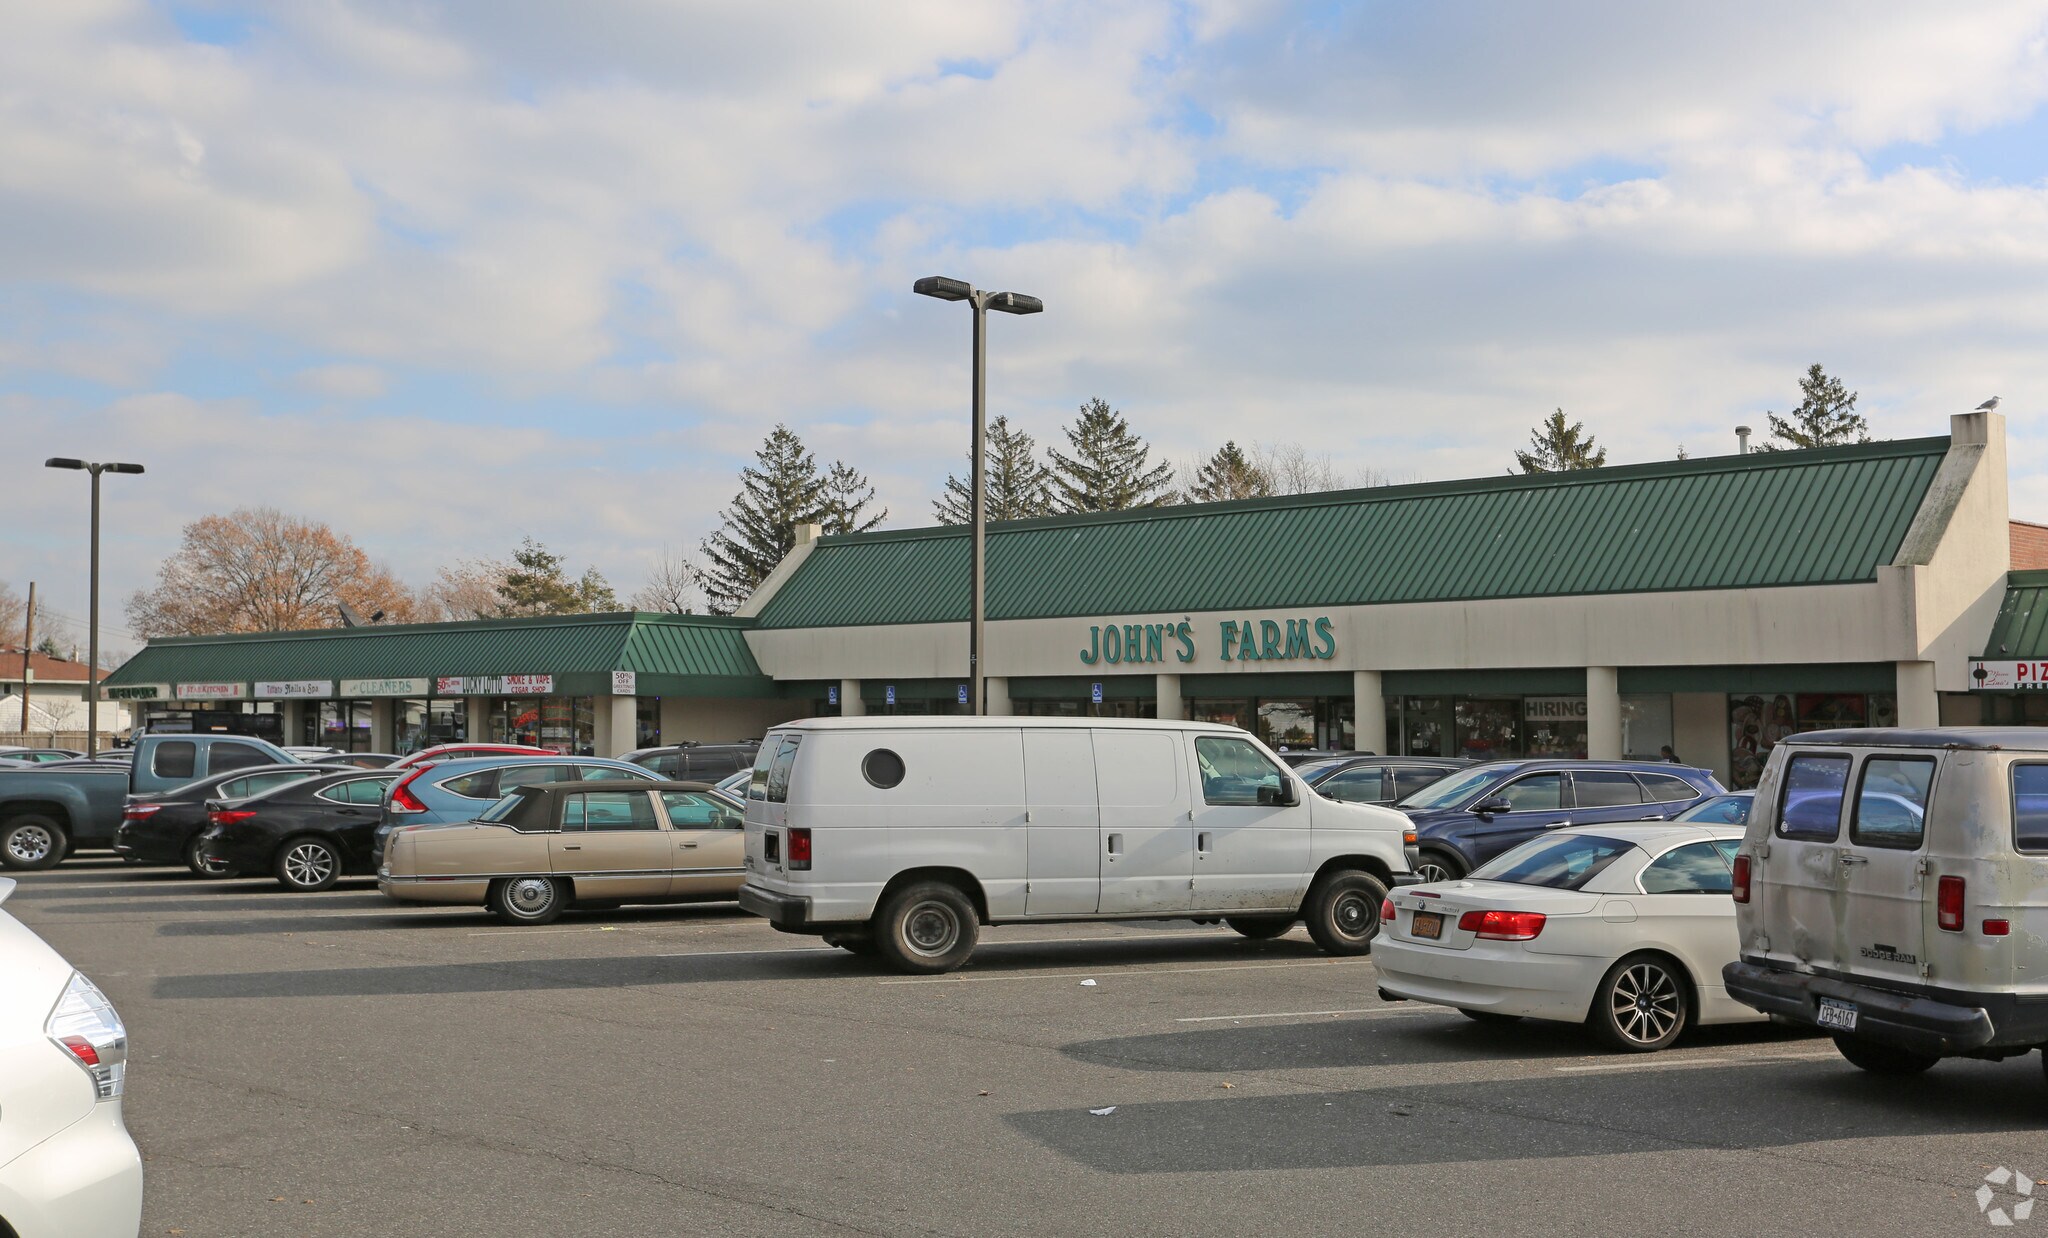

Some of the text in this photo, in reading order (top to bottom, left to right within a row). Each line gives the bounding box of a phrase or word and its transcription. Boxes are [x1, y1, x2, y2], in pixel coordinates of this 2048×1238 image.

[1080, 617, 1336, 665] JOHN'S FARMS
[359, 680, 412, 694] CLEANERS
[463, 675, 503, 694] LUCKY LOTTO
[507, 675, 550, 685] SMOKE & VAPE
[202, 685, 229, 693] KITCHEN
[284, 683, 302, 695] Nails
[307, 683, 319, 695] Spa
[511, 686, 546, 694] CIGAR SHOP
[1527, 702, 1587, 716] HIRING
[1860, 947, 1917, 964] DODGE RAM
